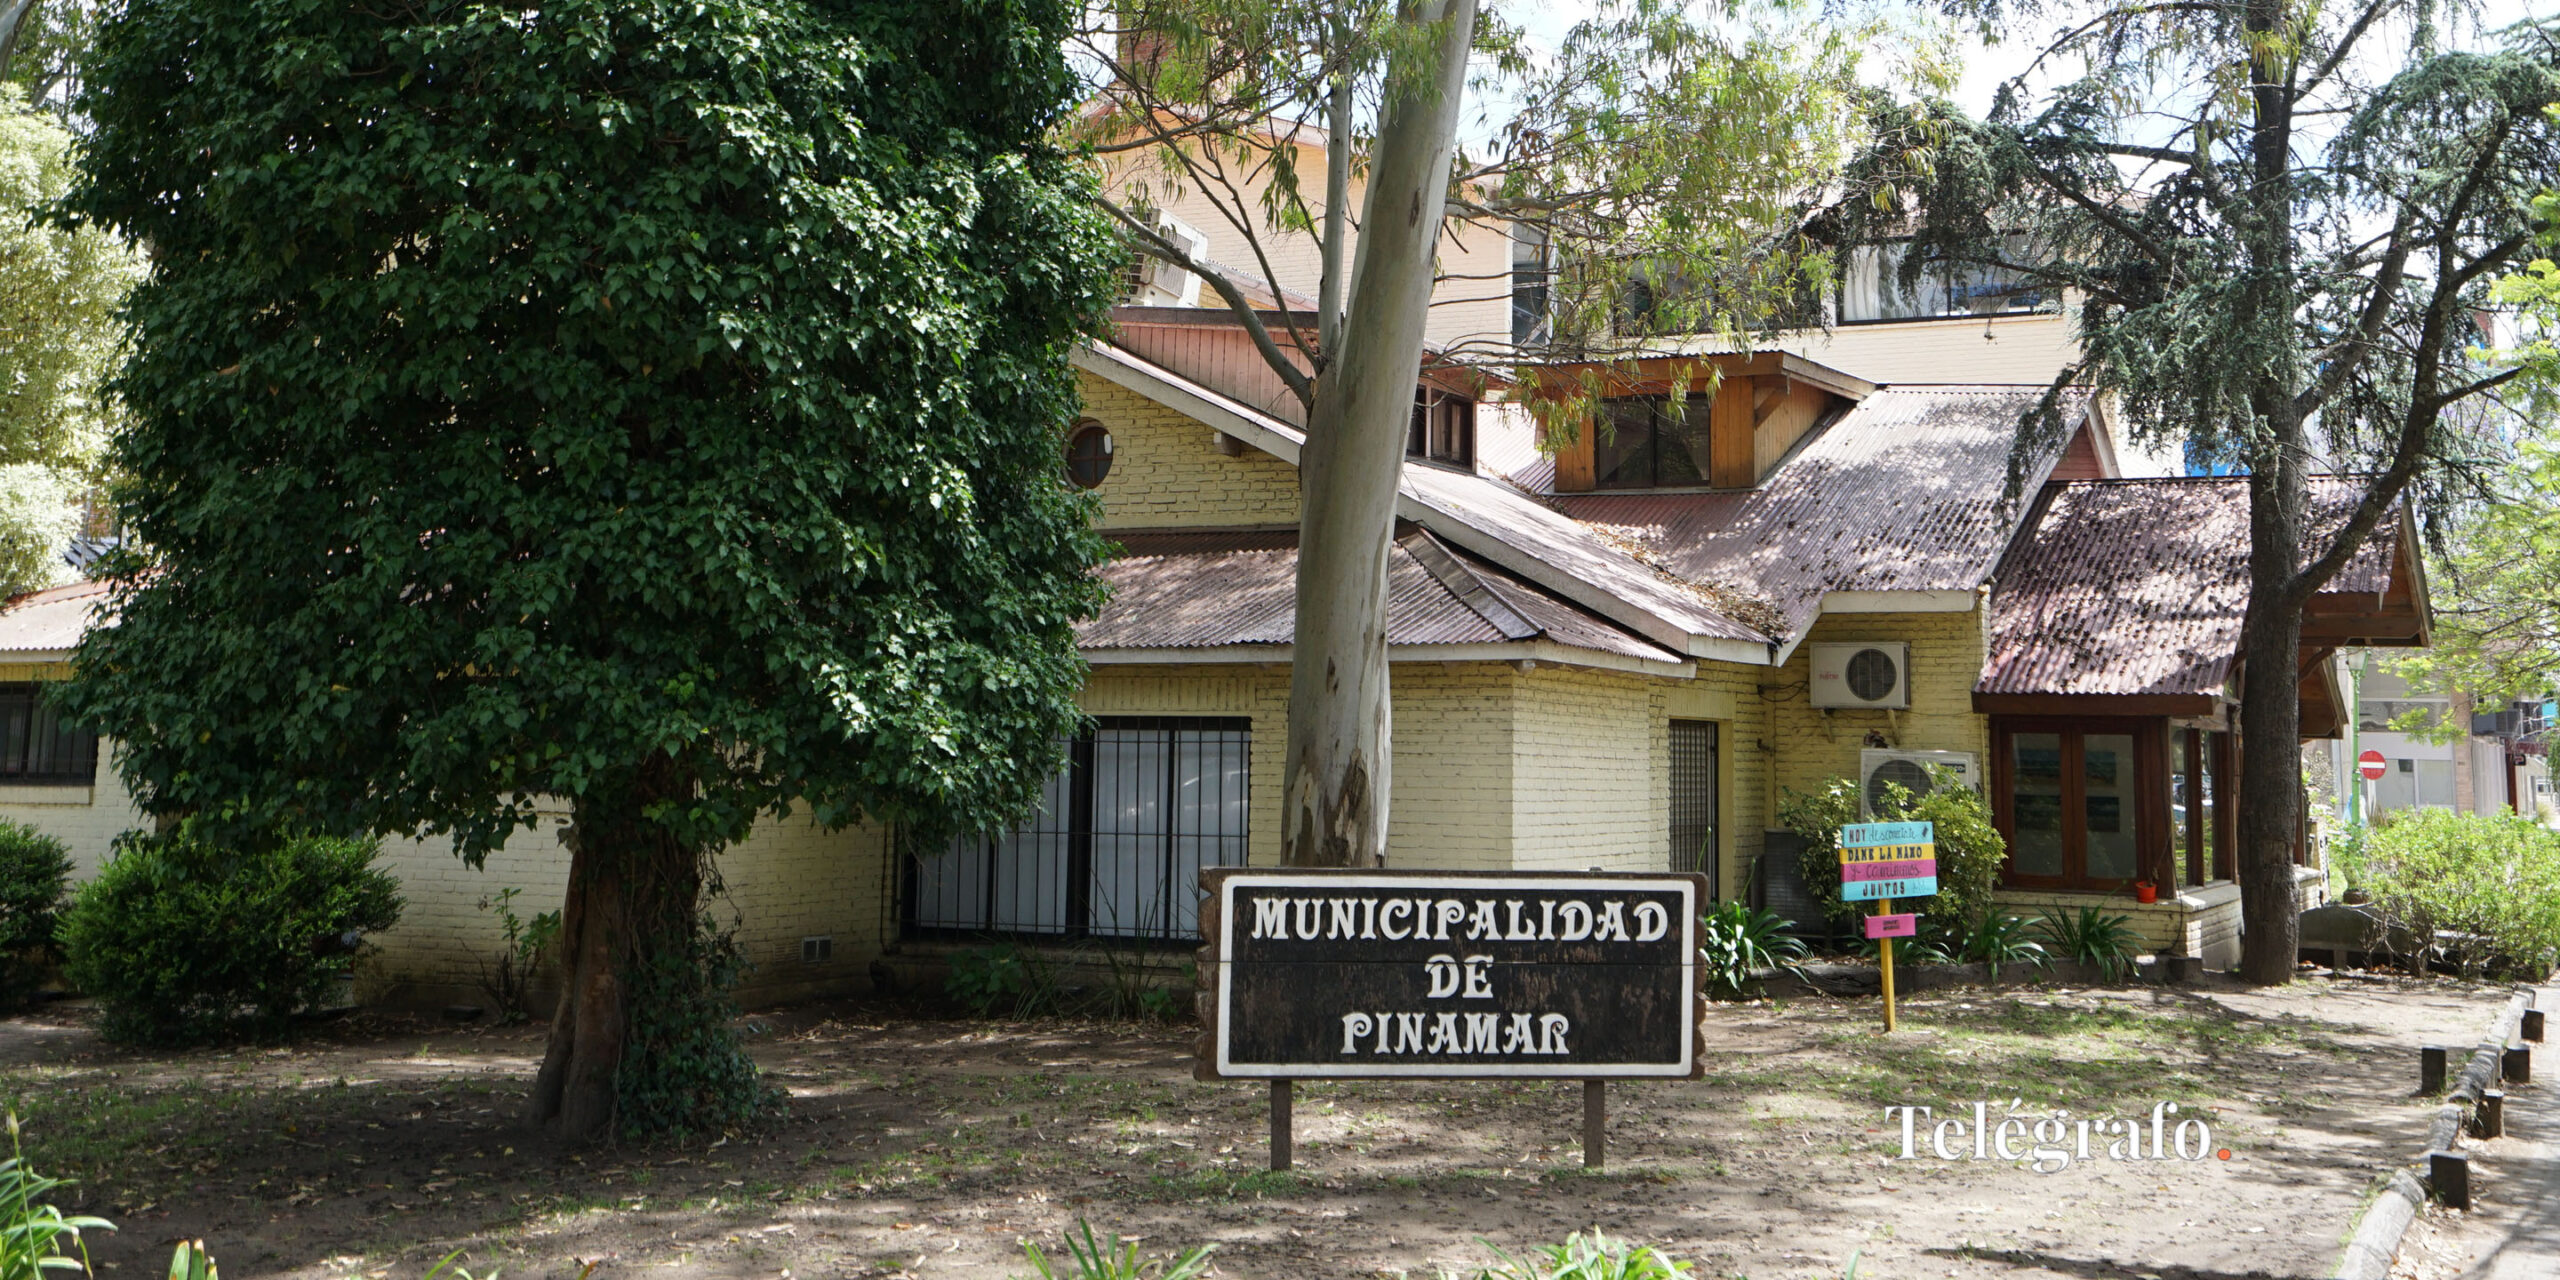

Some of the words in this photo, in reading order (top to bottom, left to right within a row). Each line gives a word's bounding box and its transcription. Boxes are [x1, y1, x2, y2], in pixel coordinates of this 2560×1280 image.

[1849, 829, 1865, 842] HOY
[1848, 848, 1874, 861] DAME
[1880, 847, 1893, 860] LA
[1896, 847, 1922, 859] MANO
[1863, 882, 1905, 896] JUNTOS
[1251, 897, 1669, 942] MUNICIPALIDAD
[1424, 954, 1494, 999] DE
[1340, 1011, 1570, 1055] PINAMAR
